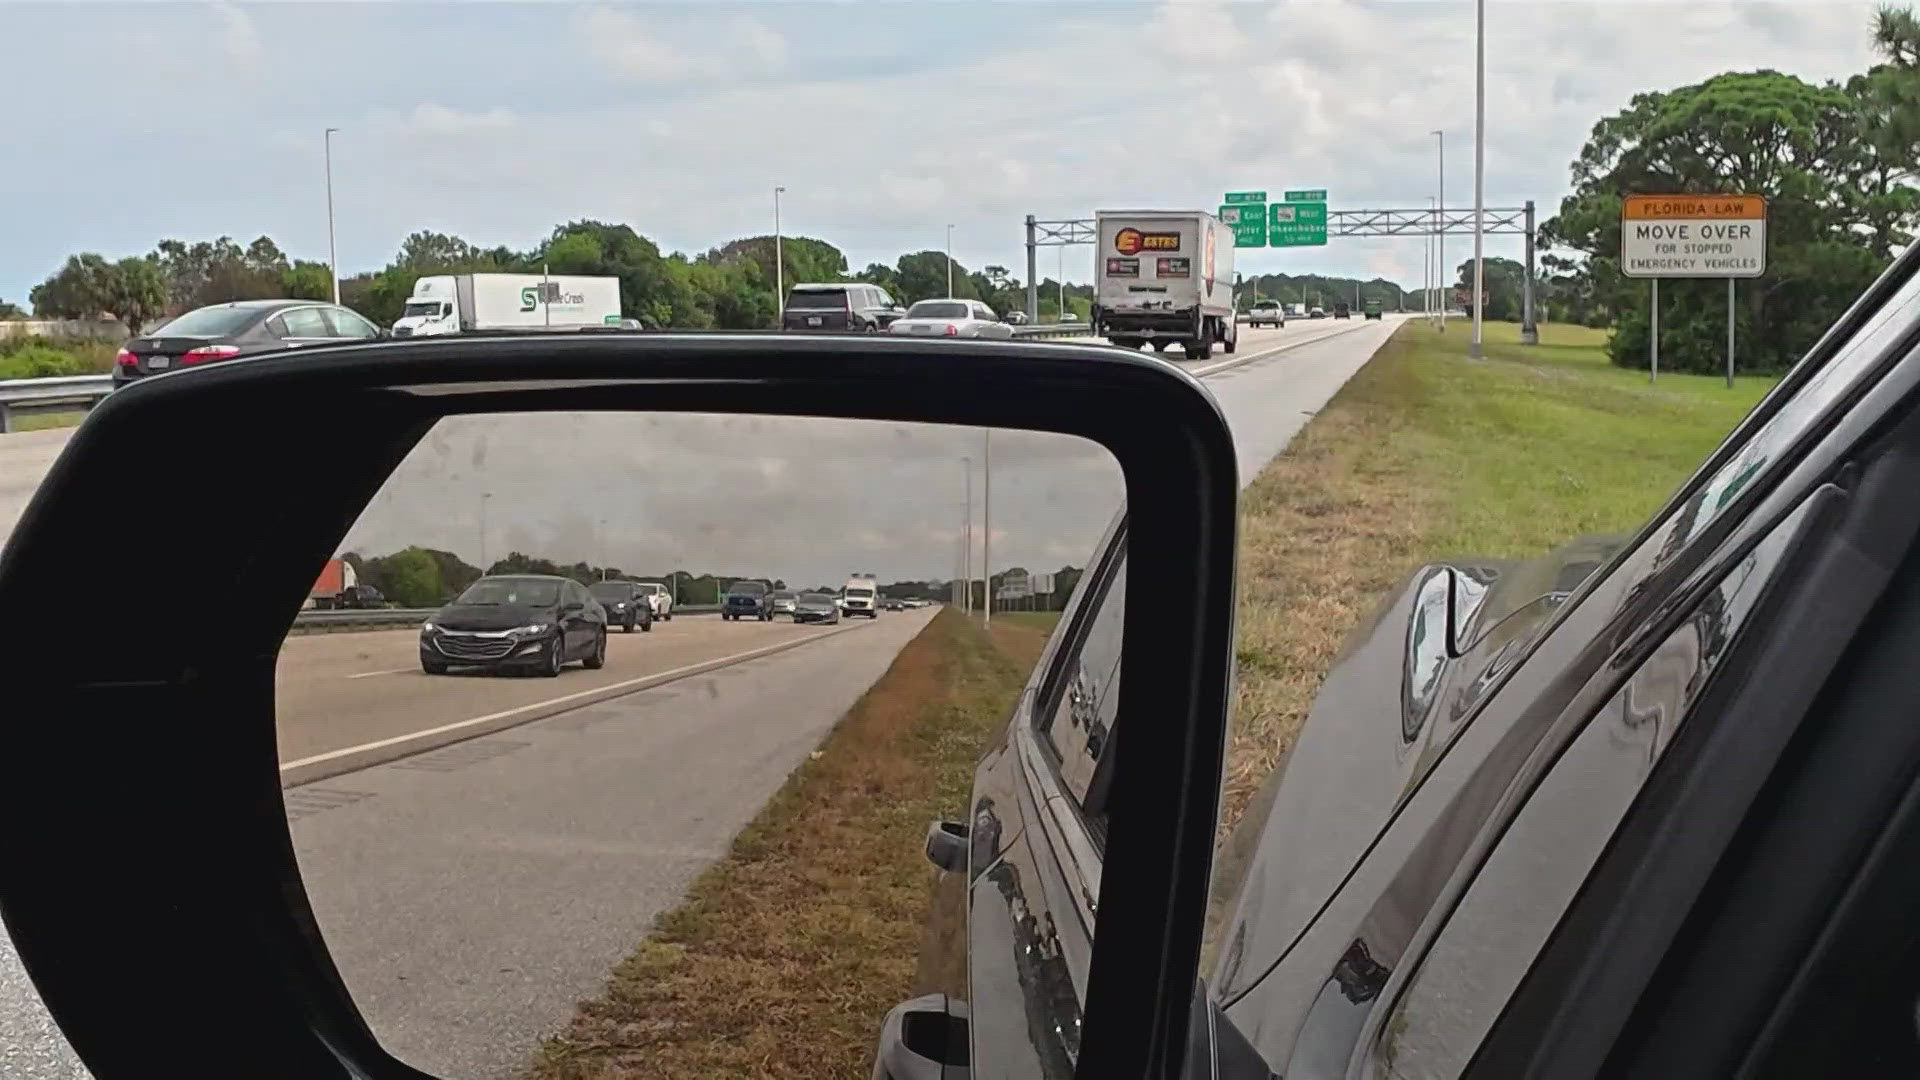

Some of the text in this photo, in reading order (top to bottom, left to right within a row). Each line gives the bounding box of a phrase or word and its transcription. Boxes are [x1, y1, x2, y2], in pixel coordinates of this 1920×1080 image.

[1644, 202, 1744, 215] FLORIDA LAW
[1636, 225, 1751, 240] MOVE OVER
[1143, 236, 1178, 249] ESTES
[1655, 243, 1732, 254] FOR STOPPED
[1631, 258, 1757, 269] EMERGENCY VEHICLES
